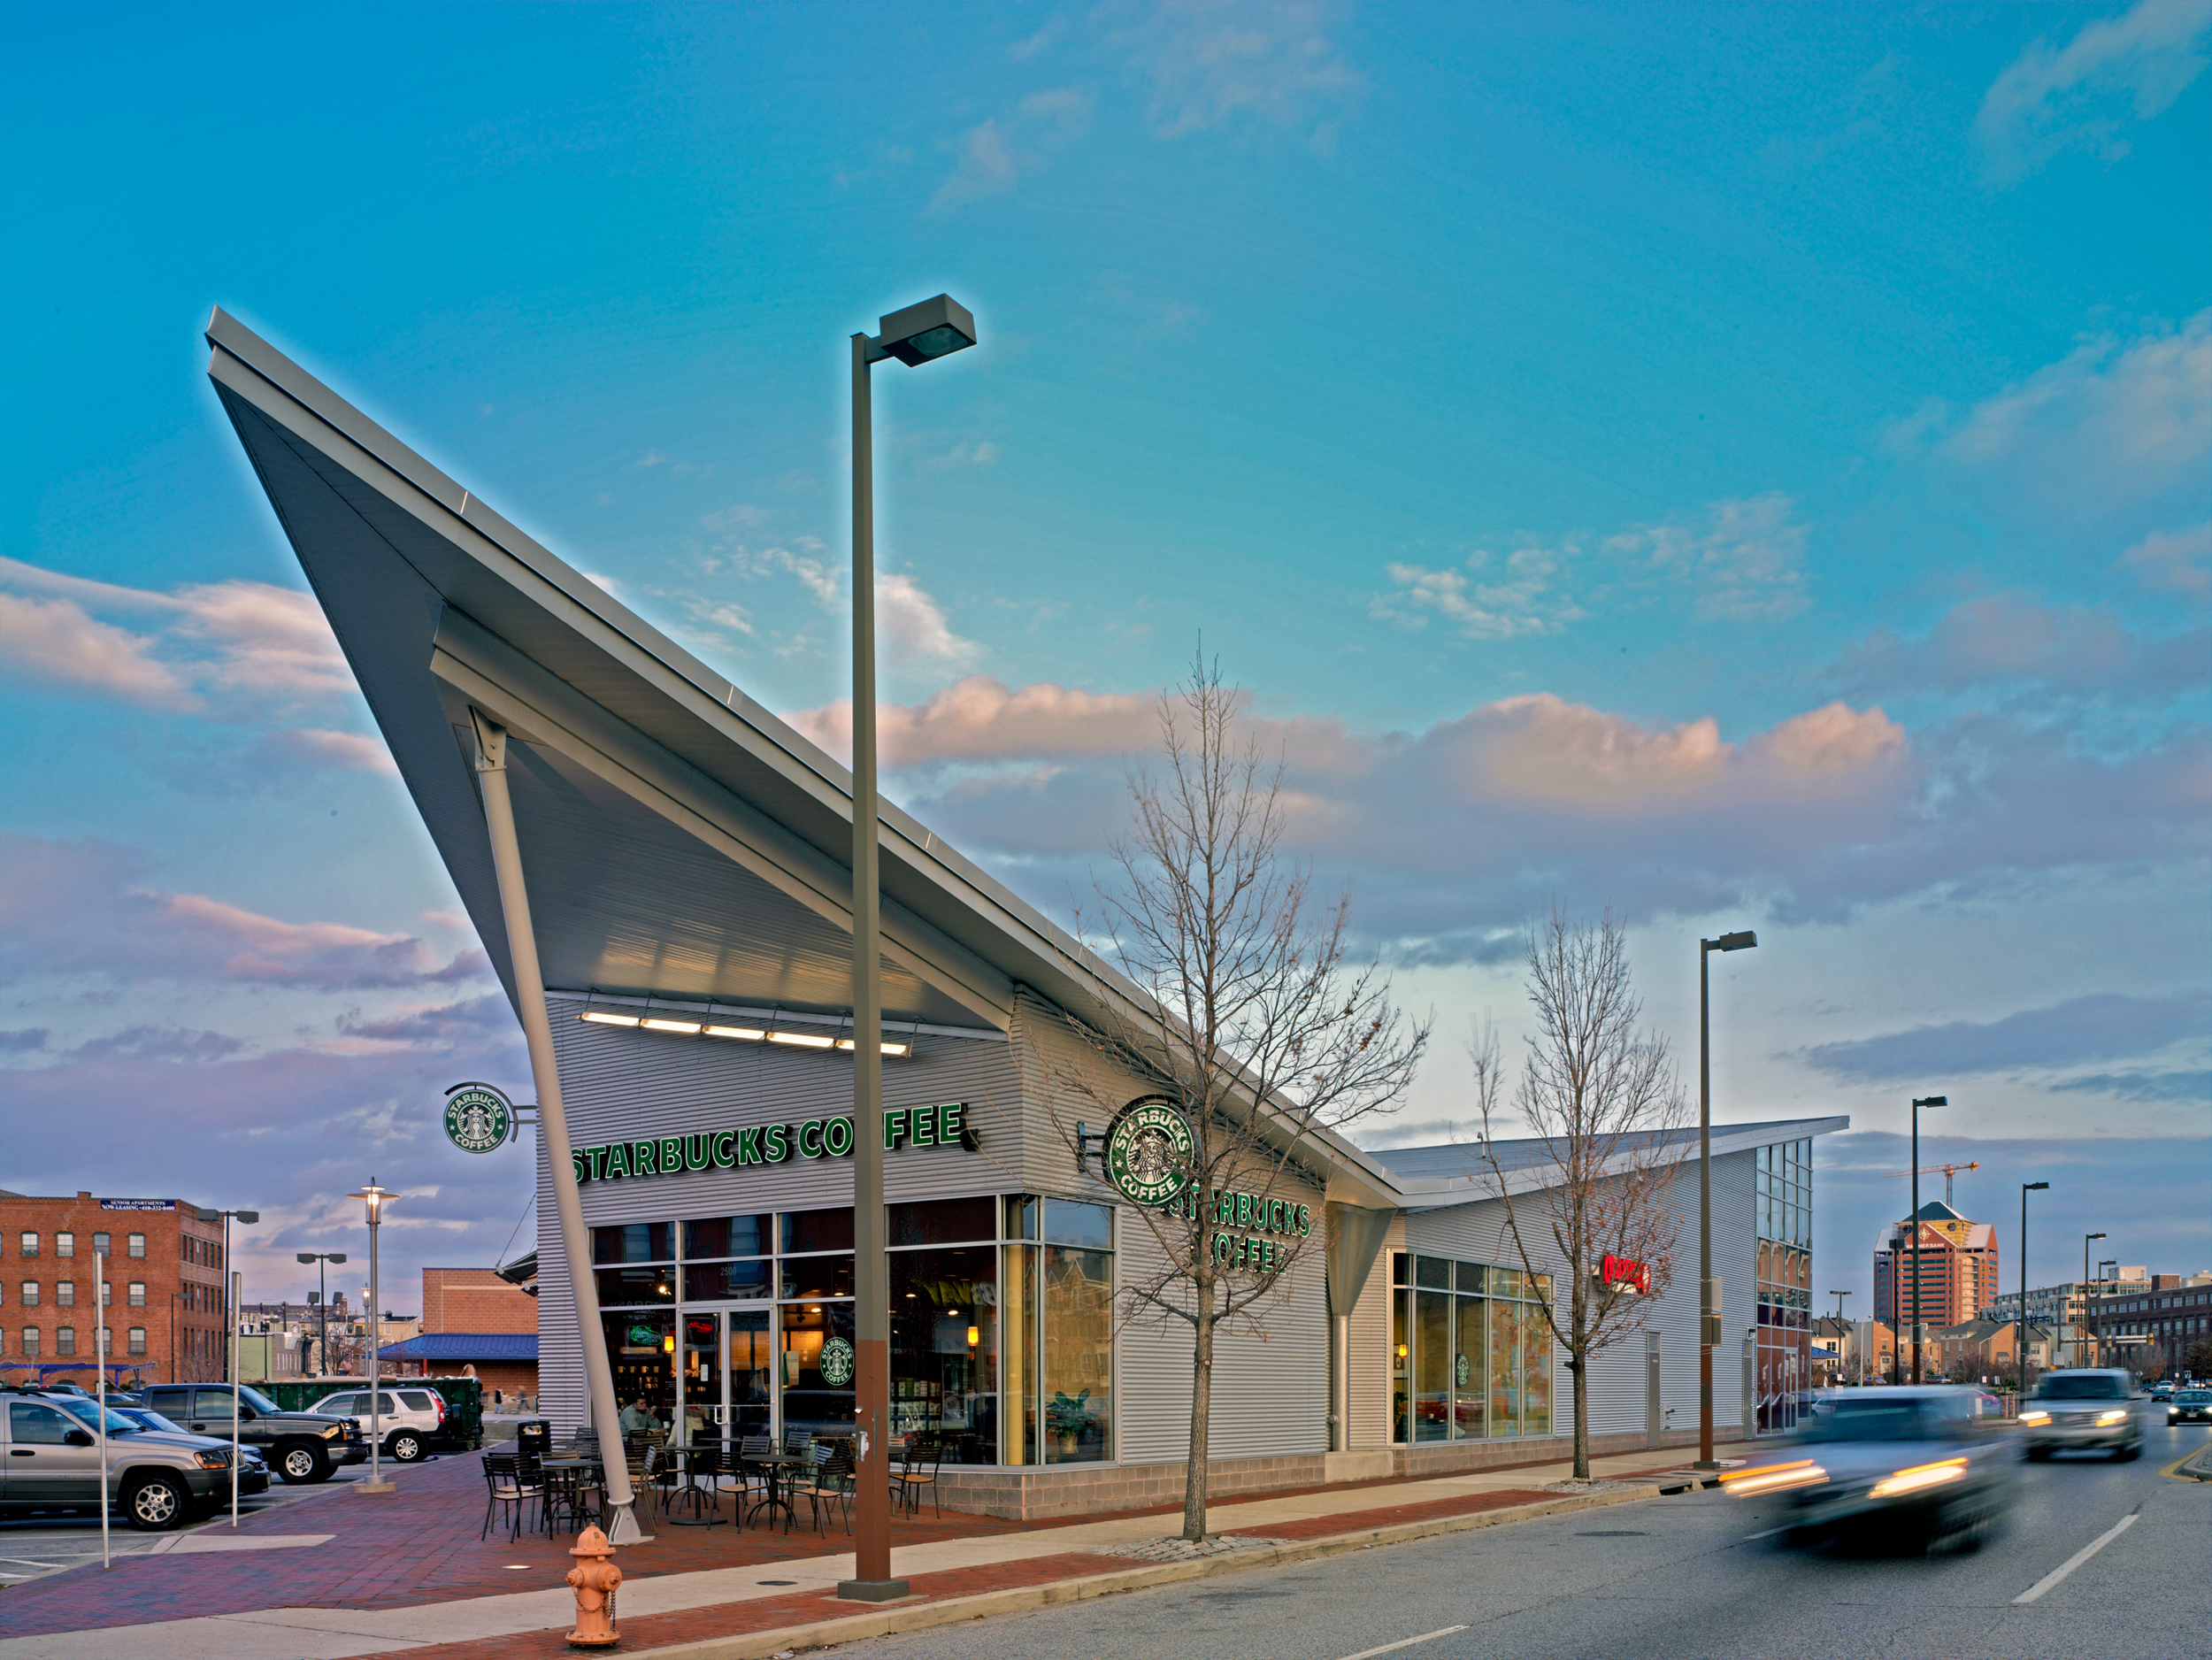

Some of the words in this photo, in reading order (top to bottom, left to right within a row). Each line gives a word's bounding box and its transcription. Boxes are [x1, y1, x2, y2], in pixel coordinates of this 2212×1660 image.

[448, 1093, 504, 1119] STARBUCKS
[455, 1134, 498, 1149] COFFEE
[797, 1103, 962, 1158] COFEE
[1120, 1174, 1178, 1201] COFFEE
[1209, 1232, 1287, 1275] OFFEE
[720, 1266, 737, 1276] 2500
[821, 1339, 853, 1360] STARBUCKS
[825, 1371, 849, 1383] COFFEE
